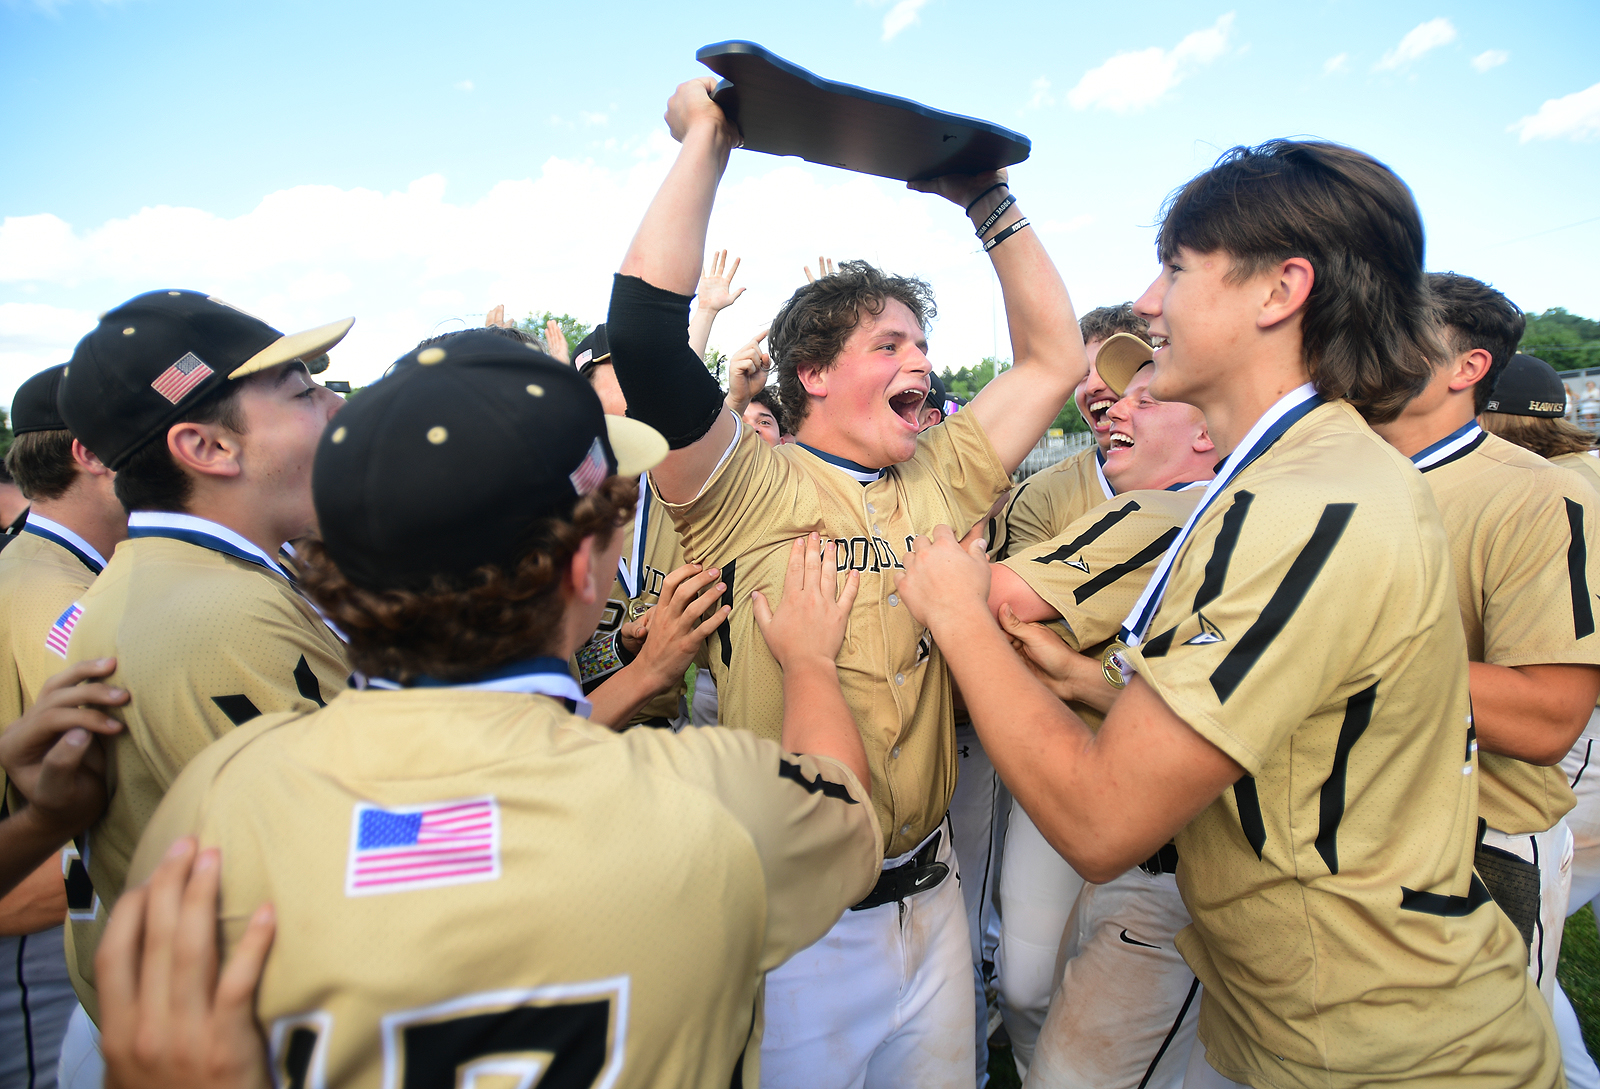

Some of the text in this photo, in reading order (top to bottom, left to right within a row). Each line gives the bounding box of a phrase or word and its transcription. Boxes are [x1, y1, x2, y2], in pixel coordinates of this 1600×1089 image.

[996, 199, 1011, 215] PROVE
[985, 213, 998, 227] THEM
[1528, 400, 1564, 412] HAWKS
